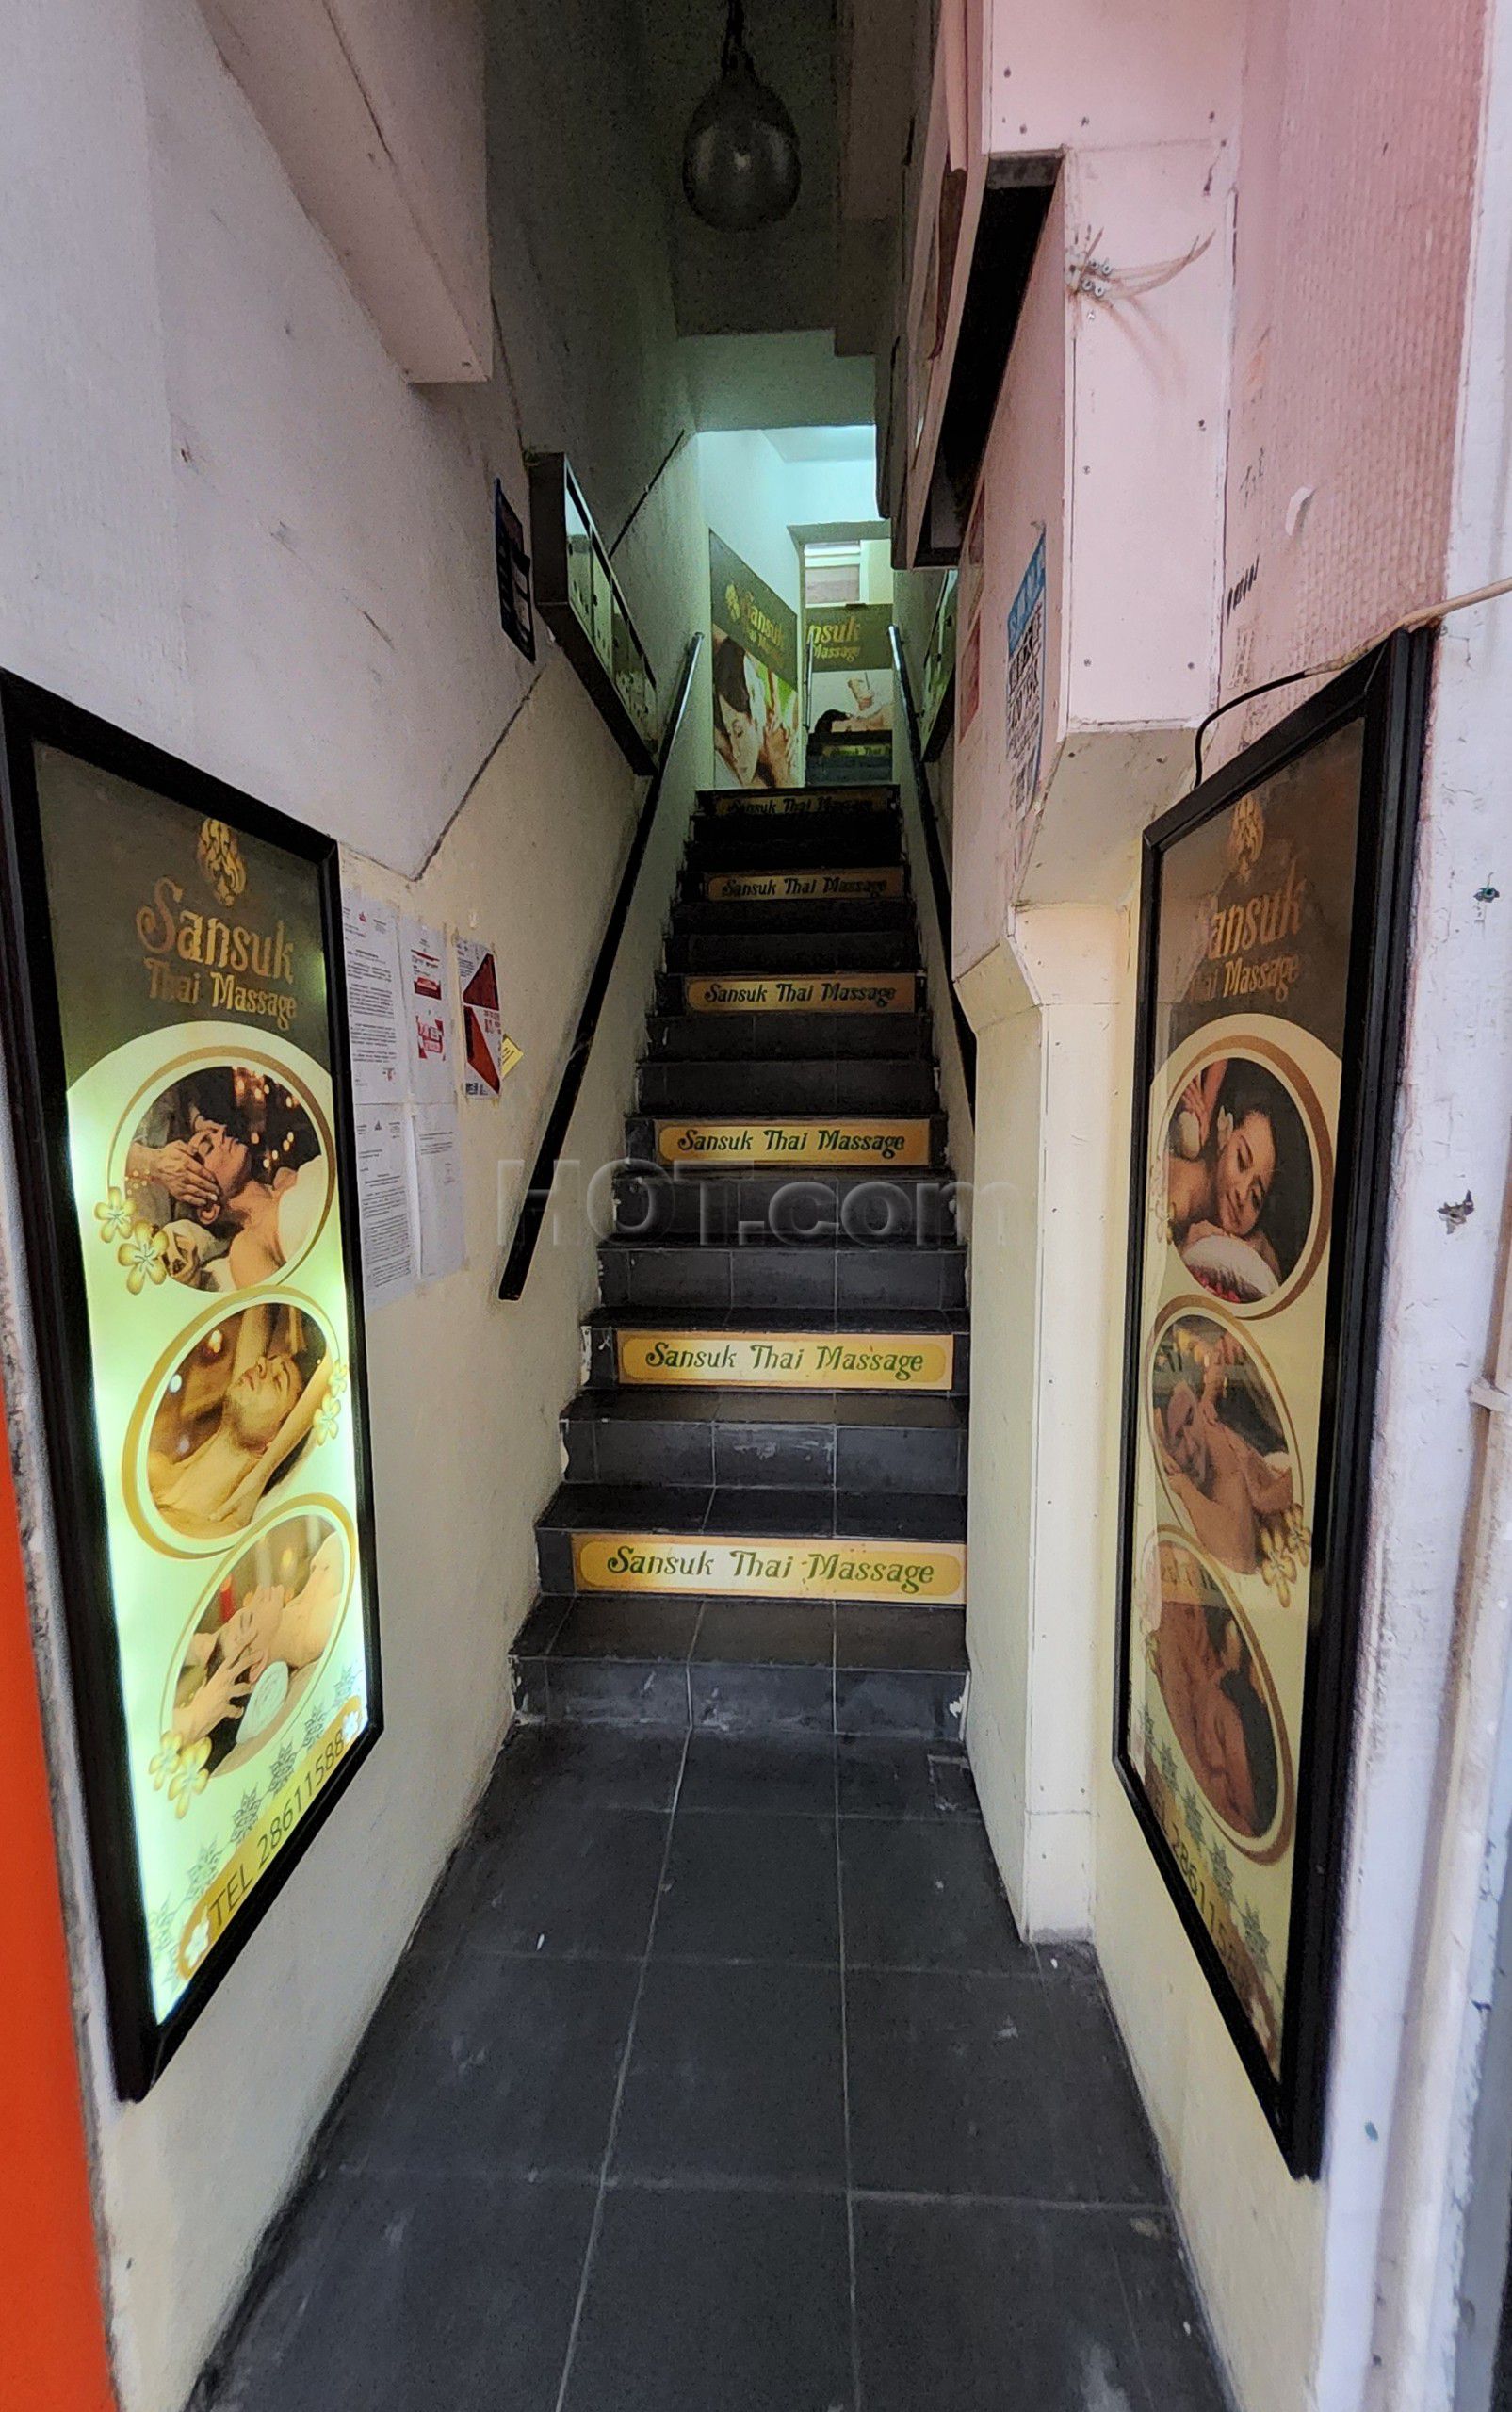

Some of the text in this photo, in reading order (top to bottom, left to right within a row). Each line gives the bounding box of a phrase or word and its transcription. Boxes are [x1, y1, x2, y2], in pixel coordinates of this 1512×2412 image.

[805, 615, 861, 644] nsuk
[722, 876, 887, 897] Sansuk Thai Massage
[1202, 857, 1307, 959] ansuk
[136, 875, 295, 985] Sansuk
[143, 957, 297, 1031] Thai Massage
[704, 982, 897, 1008] Sansuk Thai Massage
[1223, 953, 1300, 1002] Massage
[677, 1128, 905, 1160] Sansuk Thai Massage
[645, 1341, 924, 1381] Sansuk Thai Massage
[607, 1545, 935, 1594] Sansuk Thai Massage
[207, 1728, 345, 1929] TEL 28611588
